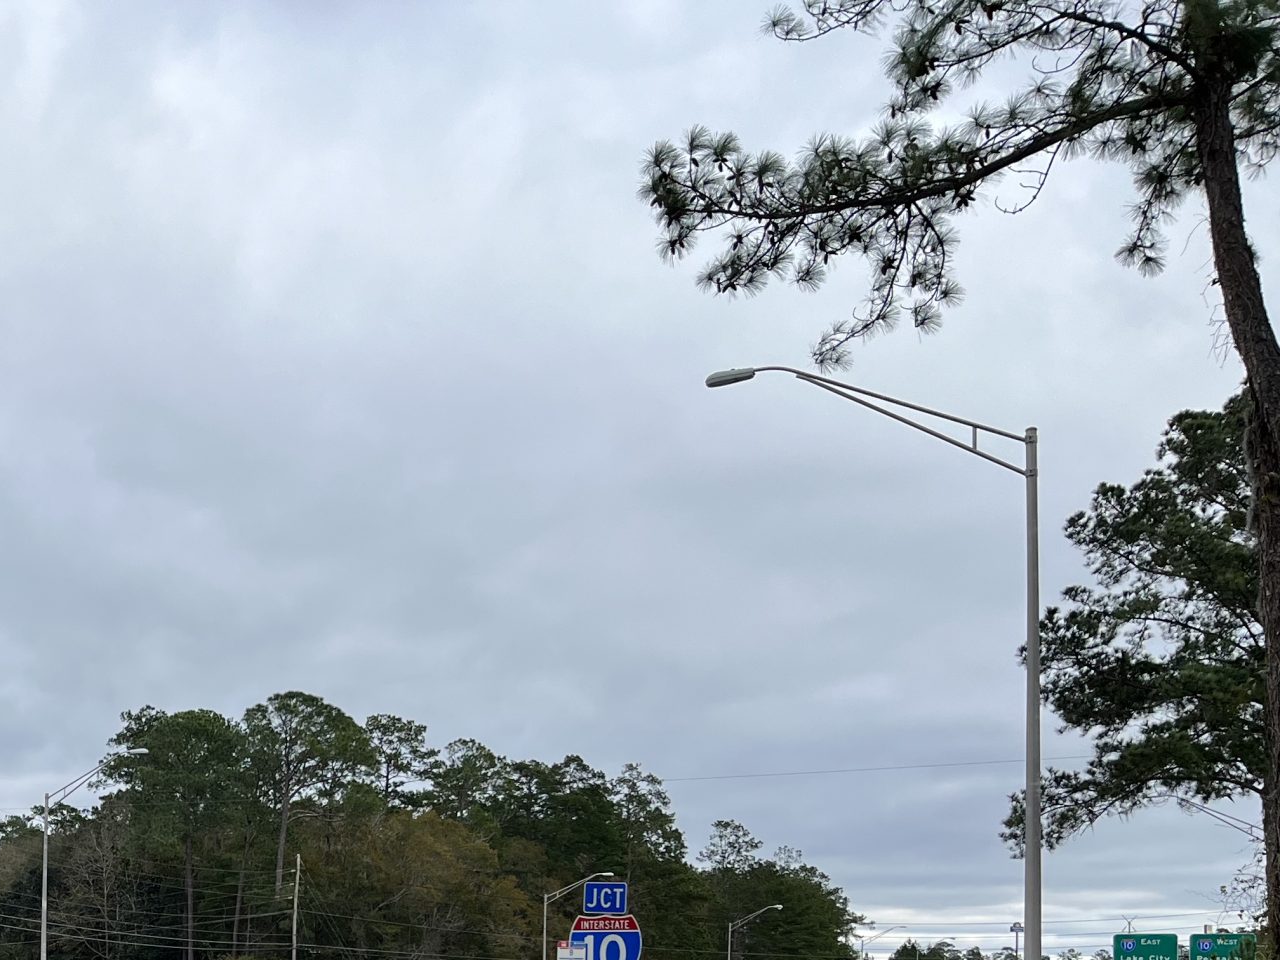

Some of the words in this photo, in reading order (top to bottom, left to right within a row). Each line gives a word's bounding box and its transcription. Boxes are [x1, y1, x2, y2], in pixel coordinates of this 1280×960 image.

[586, 888, 624, 908] JCT
[580, 920, 630, 930] INTERSTATE
[1123, 941, 1134, 950] 10
[1140, 938, 1161, 946] EAST
[1199, 941, 1210, 950] 10
